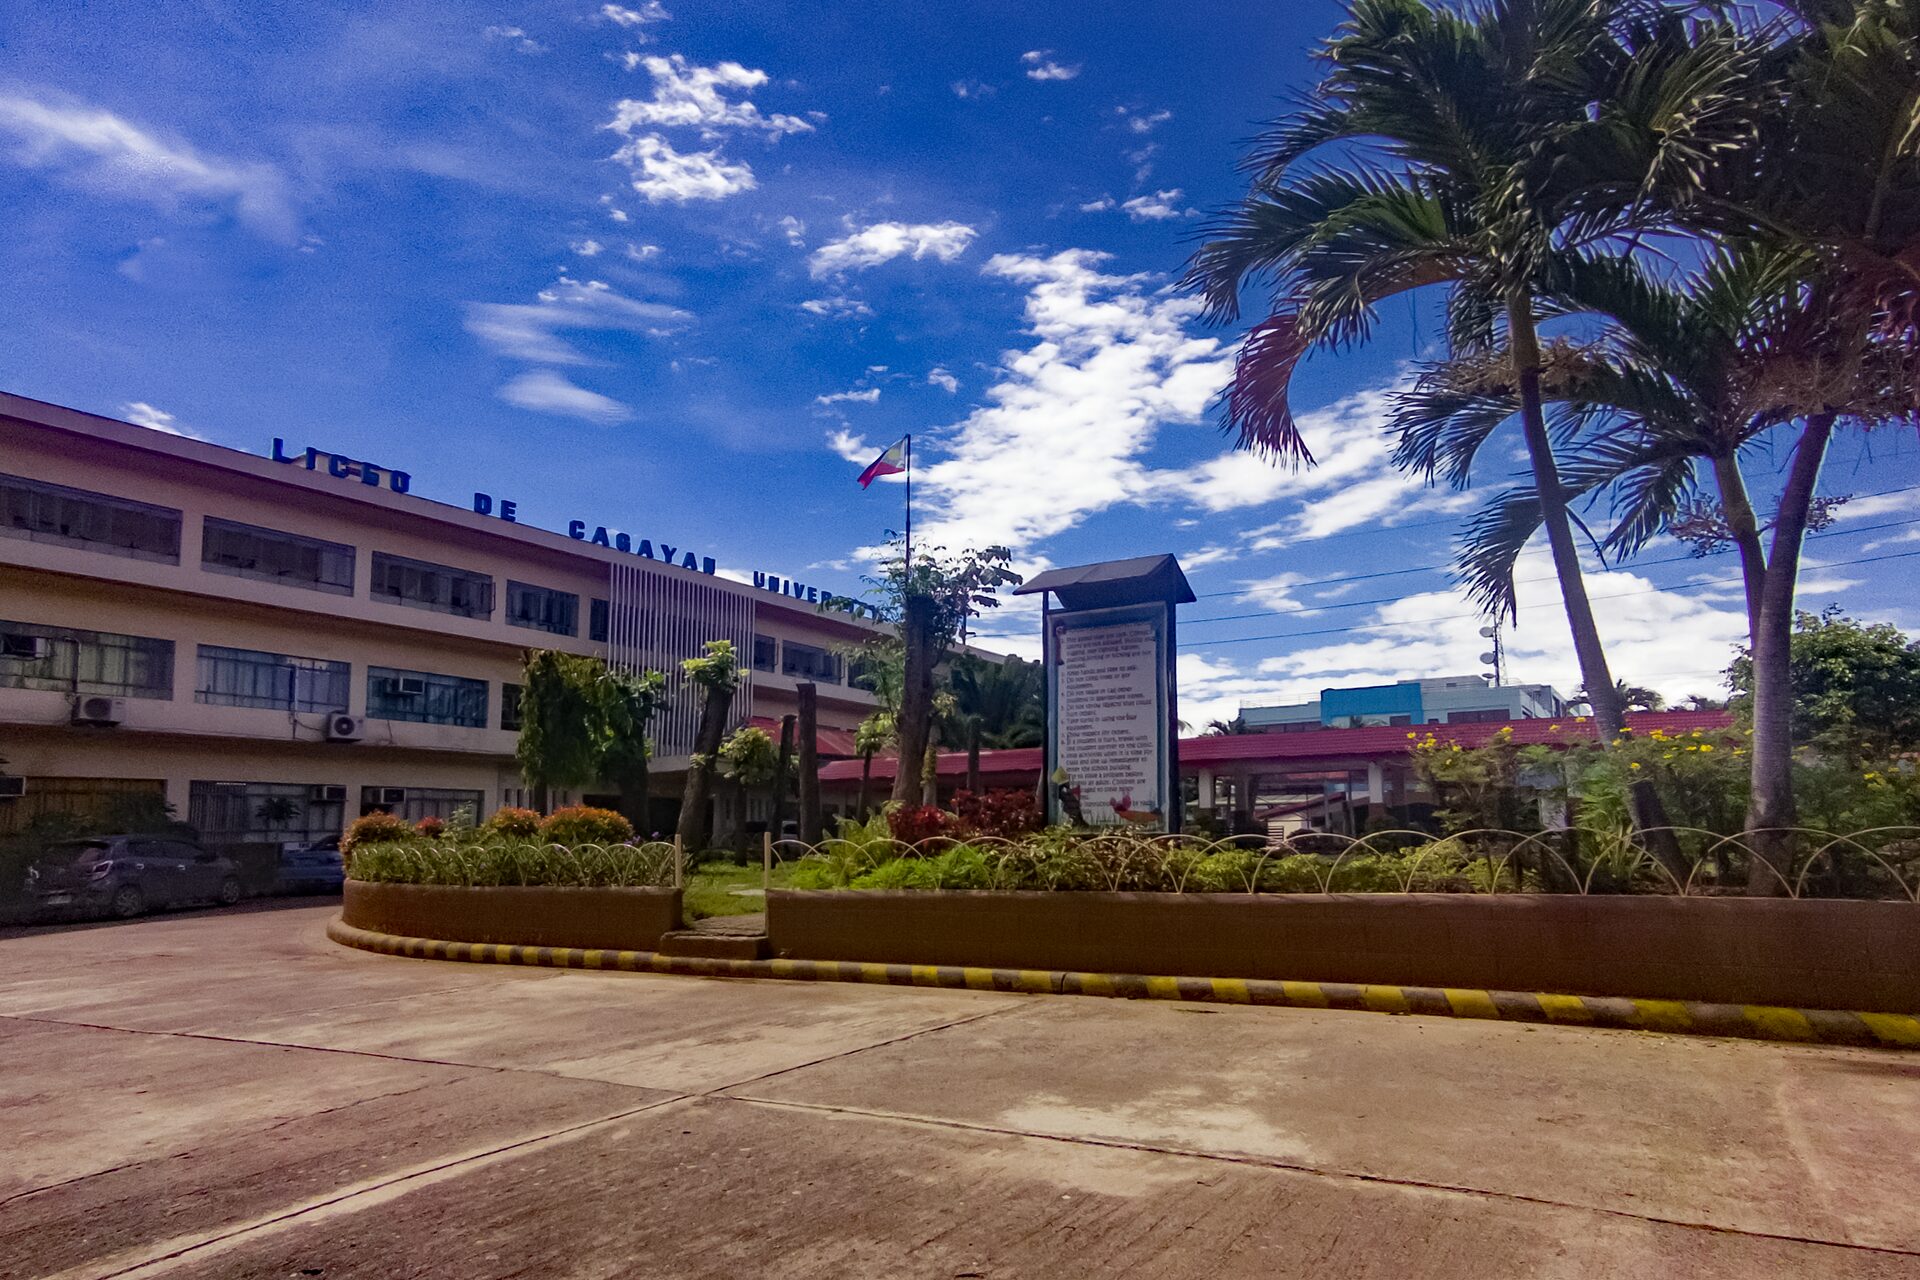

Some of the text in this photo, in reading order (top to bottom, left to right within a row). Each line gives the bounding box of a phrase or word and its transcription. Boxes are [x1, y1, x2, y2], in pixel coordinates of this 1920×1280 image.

[272, 437, 411, 493] LICEO
[474, 493, 518, 523] DE
[568, 520, 717, 576] CAGAYAN
